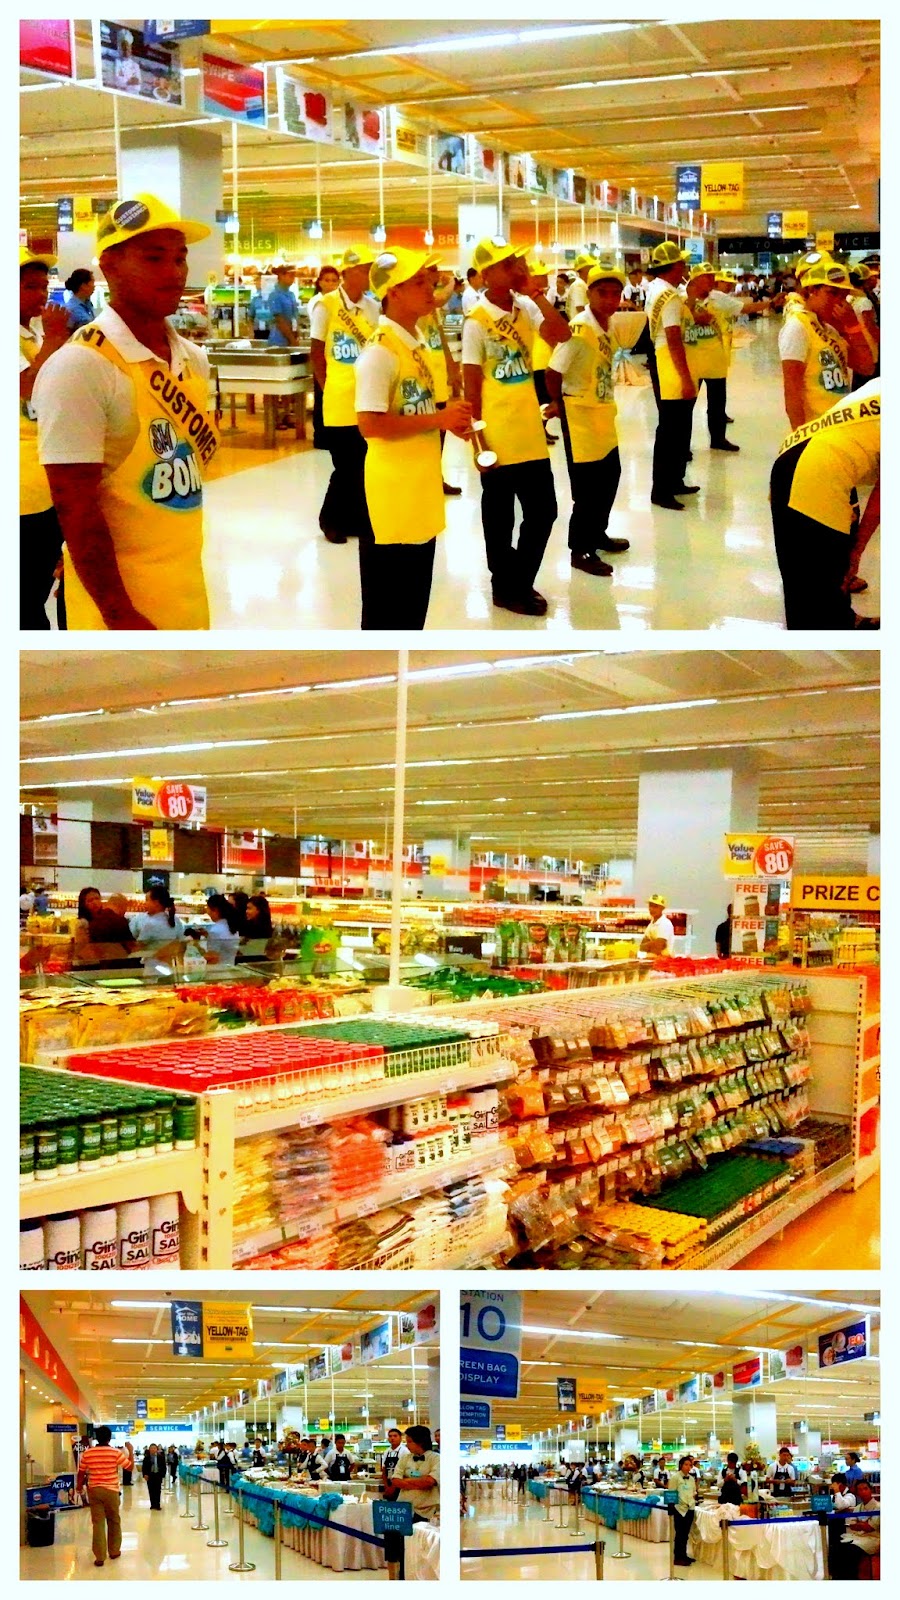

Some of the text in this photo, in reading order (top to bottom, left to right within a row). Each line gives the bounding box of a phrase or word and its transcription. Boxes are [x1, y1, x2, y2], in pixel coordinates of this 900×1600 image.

[728, 844, 755, 853] Value
[764, 841, 784, 851] SAVE
[736, 883, 768, 894] FREE
[802, 885, 860, 901] PRIZE
[733, 920, 765, 930] FREE
[460, 1302, 507, 1342] 10
[487, 1363, 507, 1373] BAG
[379, 1506, 407, 1514] Please
[381, 1514, 395, 1522] fall
[384, 1522, 400, 1531] line
